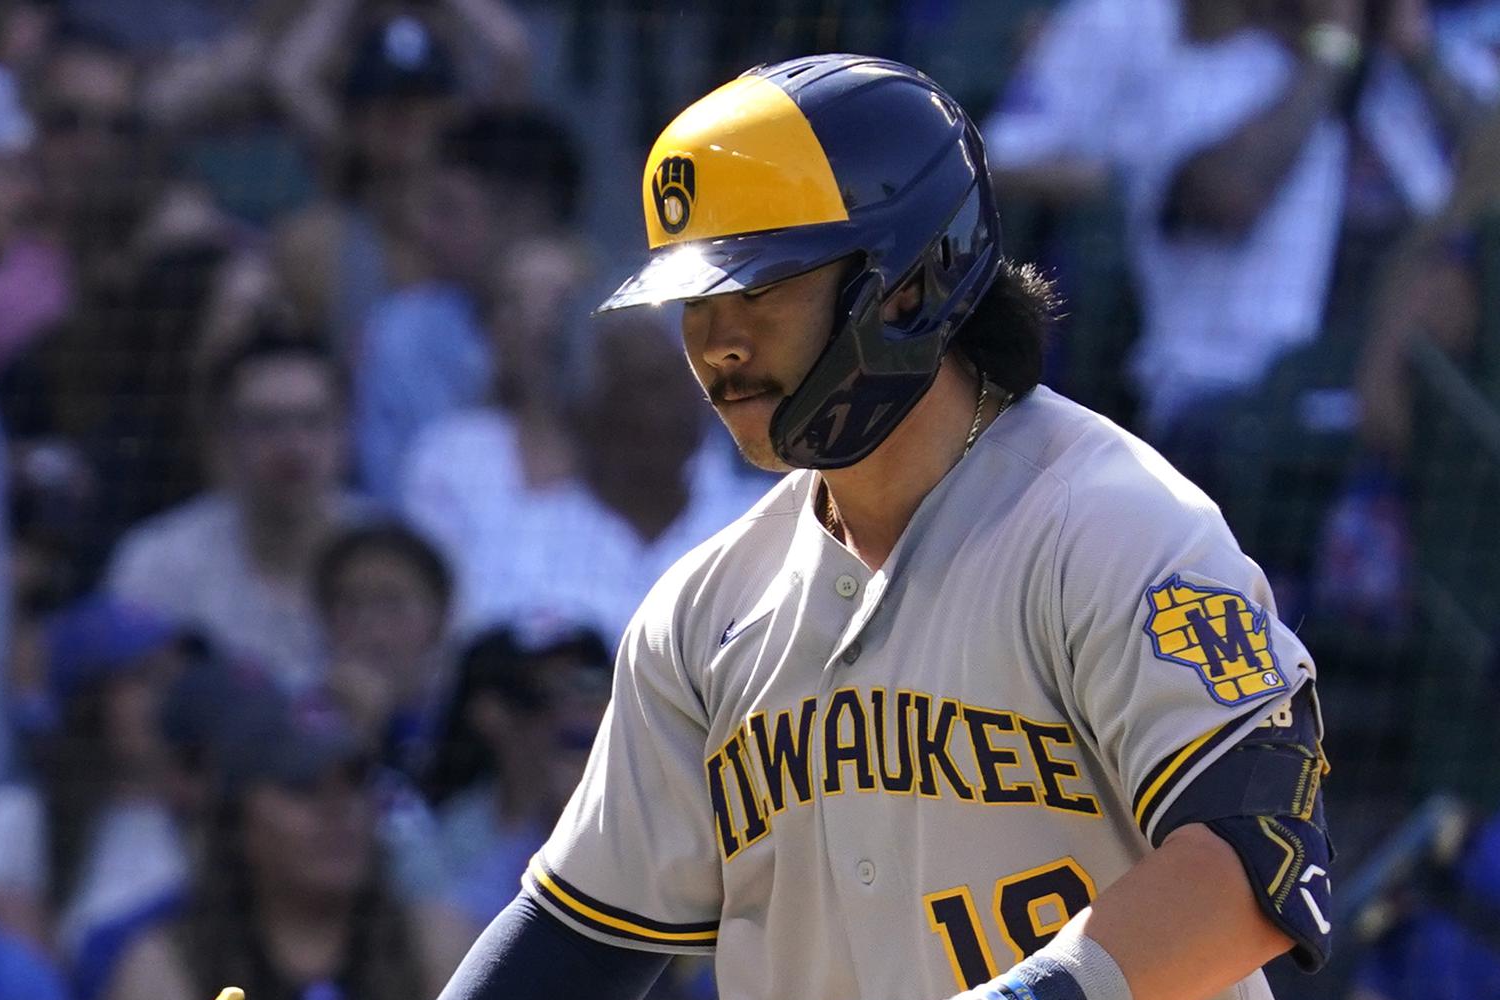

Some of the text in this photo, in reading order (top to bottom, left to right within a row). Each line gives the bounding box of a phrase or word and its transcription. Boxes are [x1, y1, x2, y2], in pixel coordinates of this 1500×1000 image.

[1184, 598, 1264, 679] M
[1256, 697, 1294, 729] 8
[704, 685, 1103, 864] IWAUKEE
